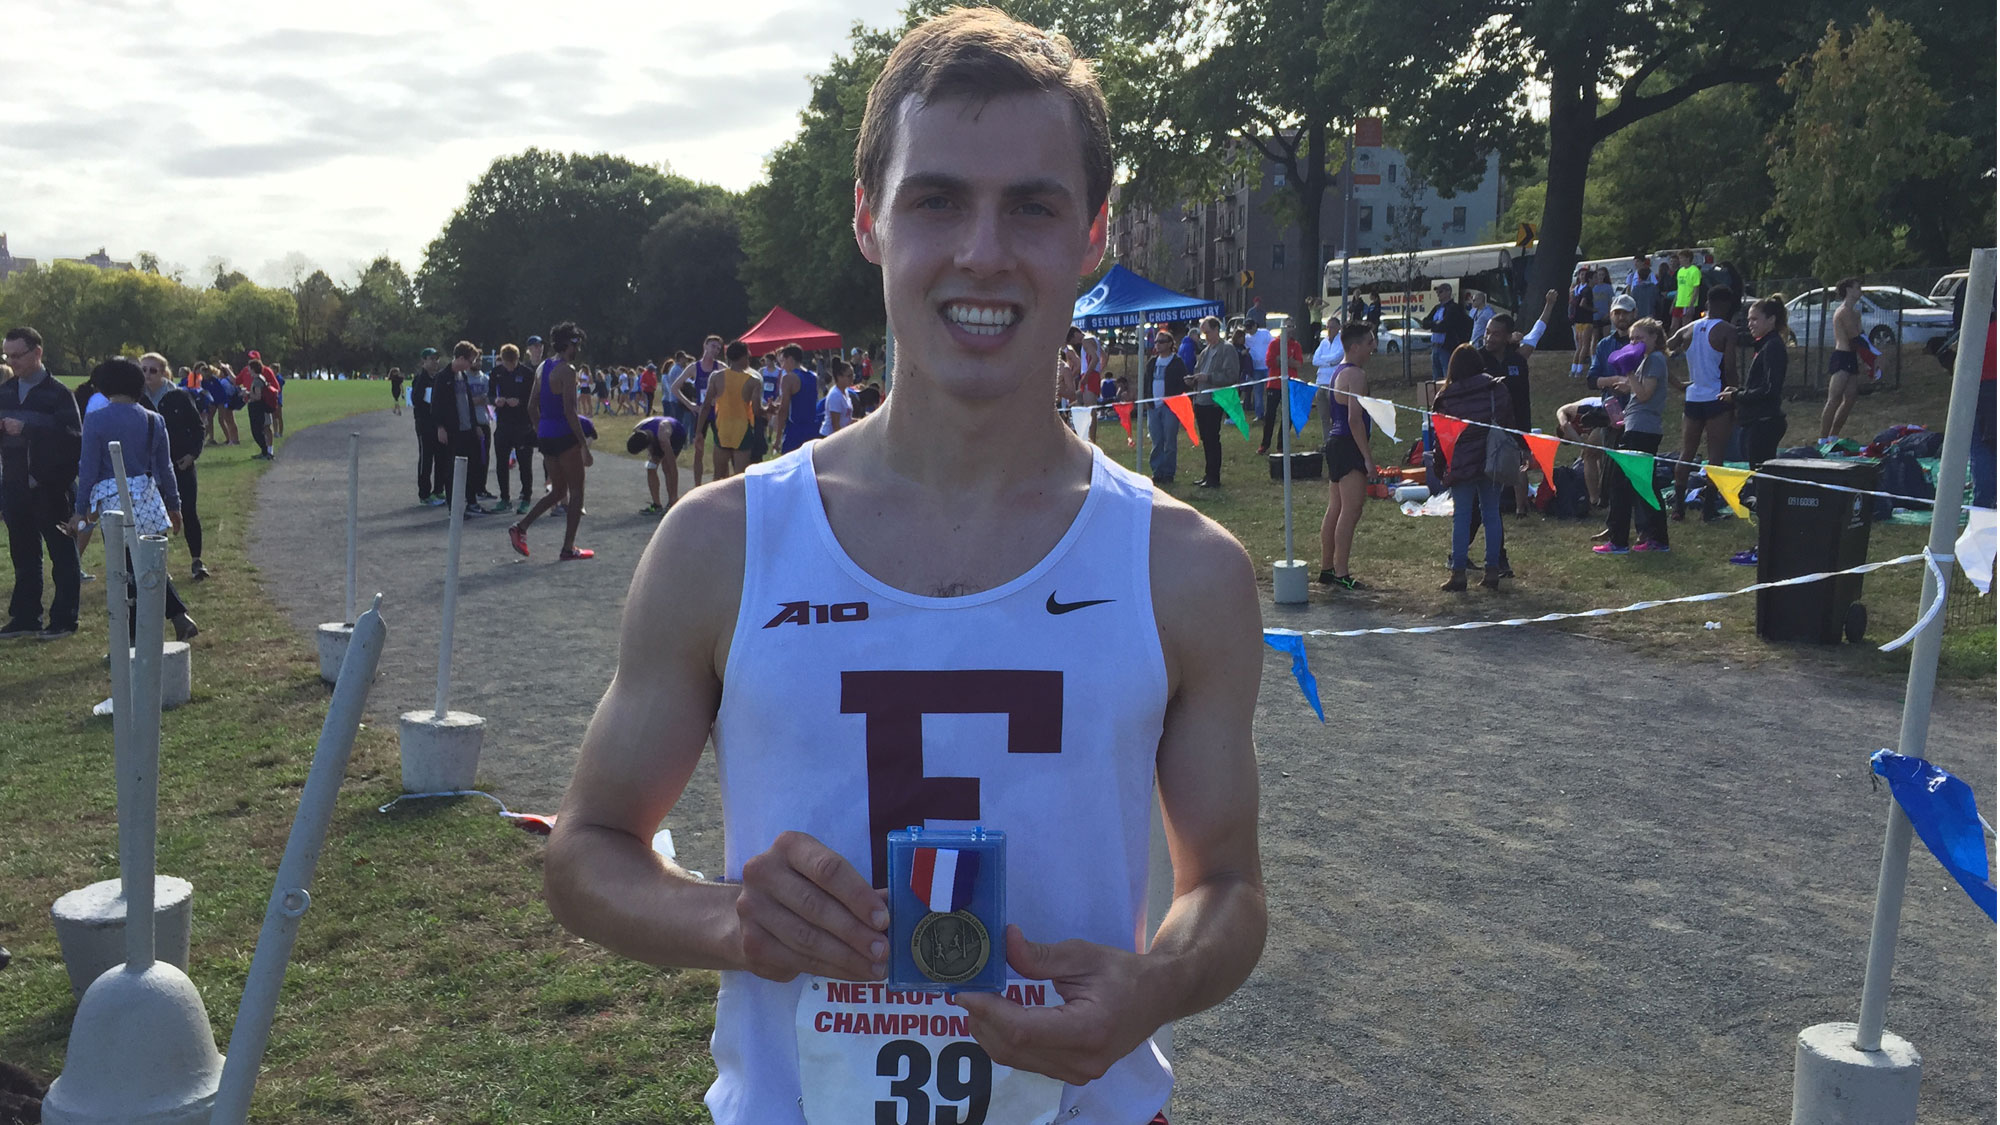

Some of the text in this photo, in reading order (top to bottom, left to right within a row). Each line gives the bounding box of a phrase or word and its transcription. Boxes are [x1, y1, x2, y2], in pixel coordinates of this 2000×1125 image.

[1092, 315, 1120, 328] SETON
[1149, 309, 1177, 323] CROSS
[1180, 305, 1220, 320] COUNTRY
[762, 600, 869, 629] A10
[840, 669, 1063, 888] F
[827, 982, 1045, 1006] METROPAN
[814, 1011, 970, 1037] CHAMPION
[875, 1039, 992, 1125] 39
